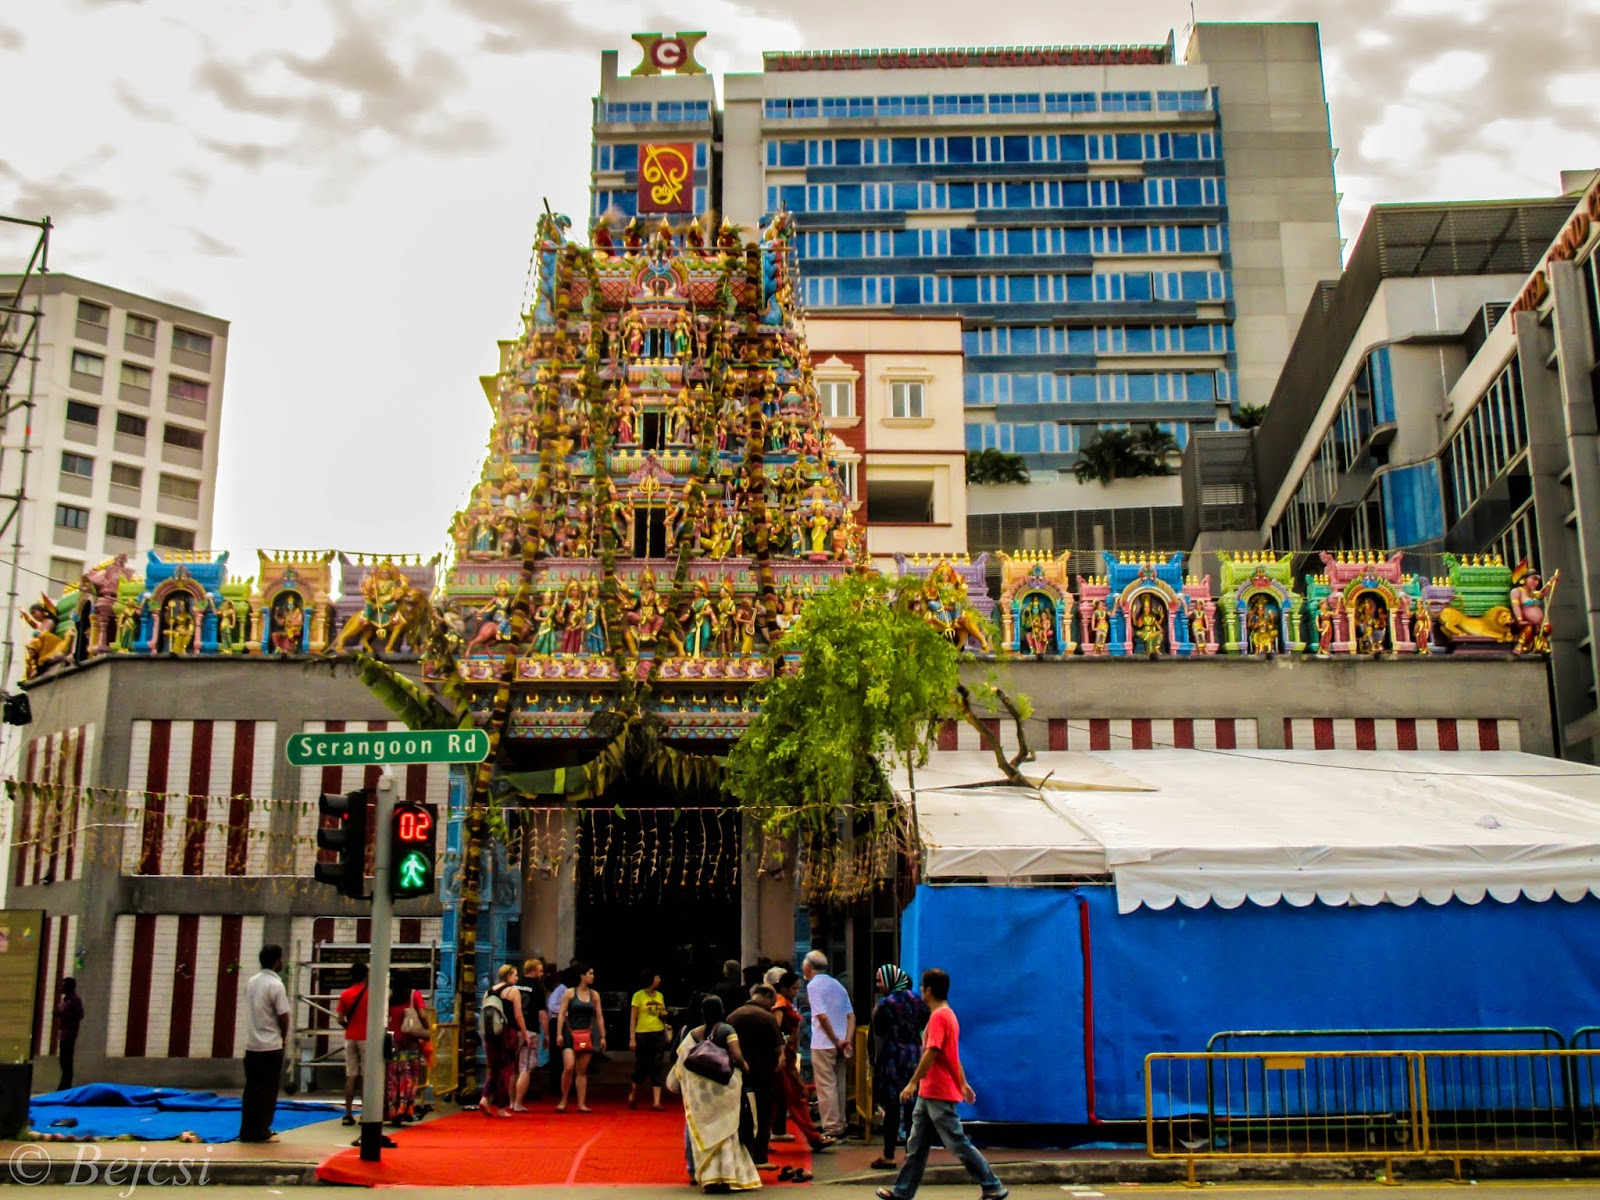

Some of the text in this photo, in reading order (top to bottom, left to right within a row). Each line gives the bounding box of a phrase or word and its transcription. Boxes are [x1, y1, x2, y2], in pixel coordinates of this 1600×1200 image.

[778, 47, 1158, 71] HOTEL GRAND CHANCELLOR
[300, 733, 477, 760] Serangoon Rd
[400, 813, 432, 841] 02
